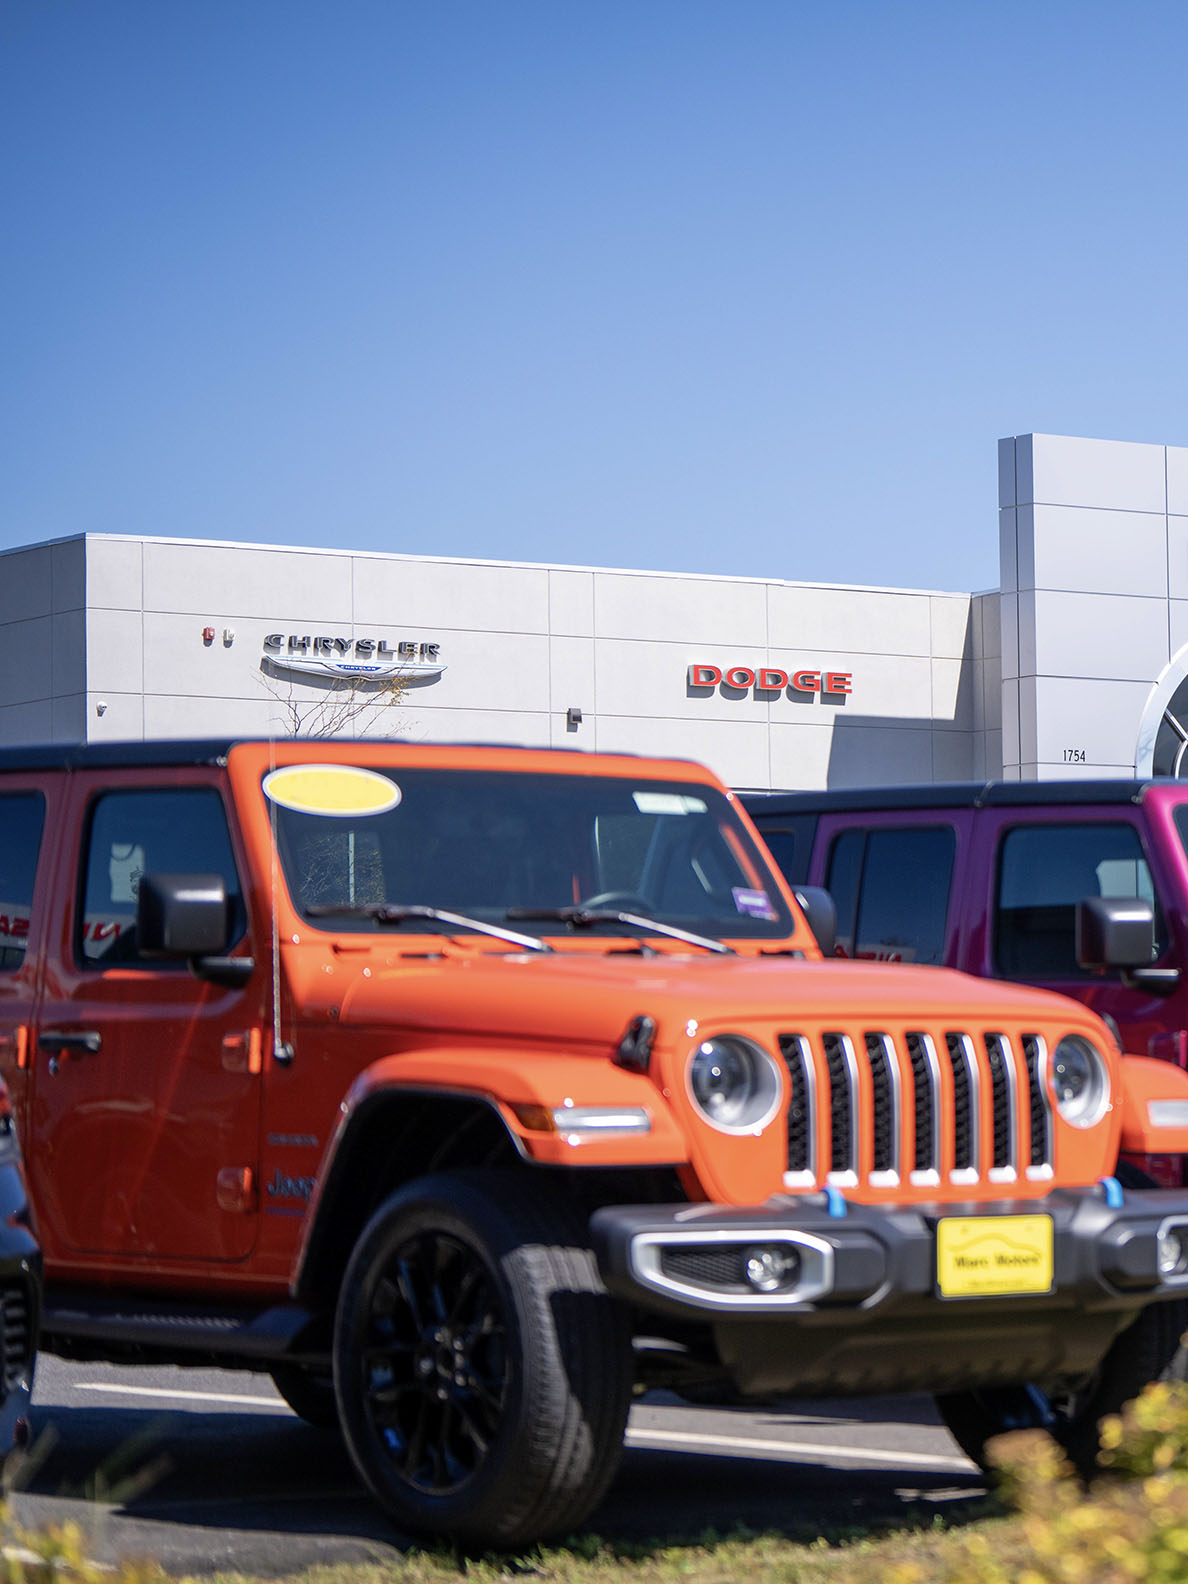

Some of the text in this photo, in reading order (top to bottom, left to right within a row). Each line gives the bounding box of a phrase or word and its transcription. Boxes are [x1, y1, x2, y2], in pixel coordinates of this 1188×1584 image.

[263, 633, 442, 656] CHRYSLER
[688, 664, 853, 694] DODGE
[1063, 749, 1086, 762] 1754
